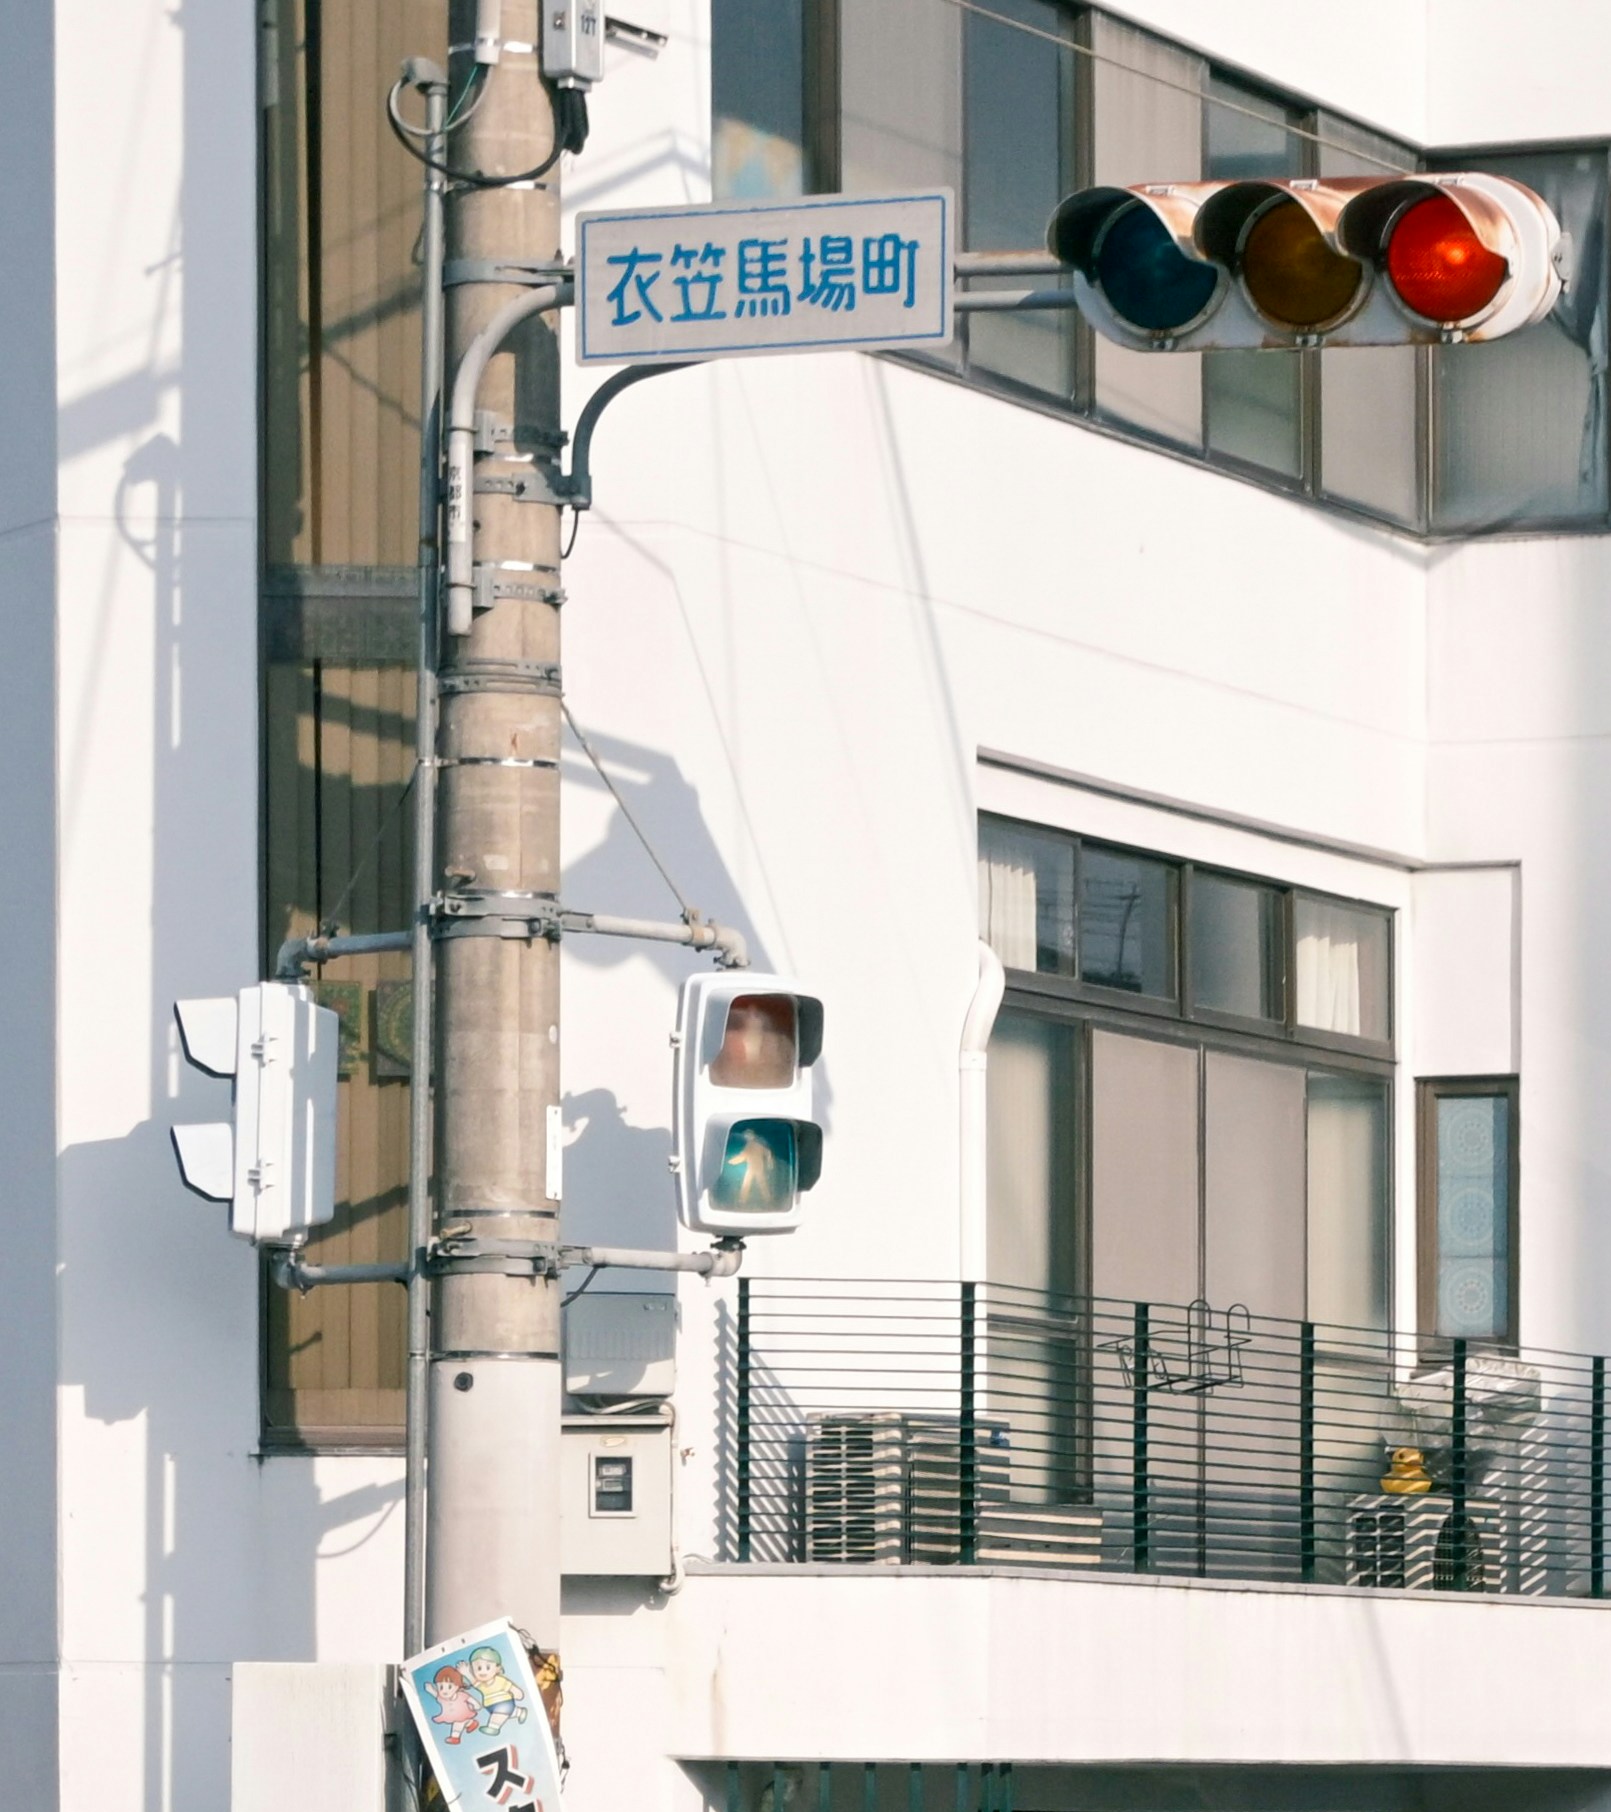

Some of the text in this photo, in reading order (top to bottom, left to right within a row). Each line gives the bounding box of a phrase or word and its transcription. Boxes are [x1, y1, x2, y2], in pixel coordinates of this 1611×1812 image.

[606, 233, 920, 326] 衣笠馬場町
